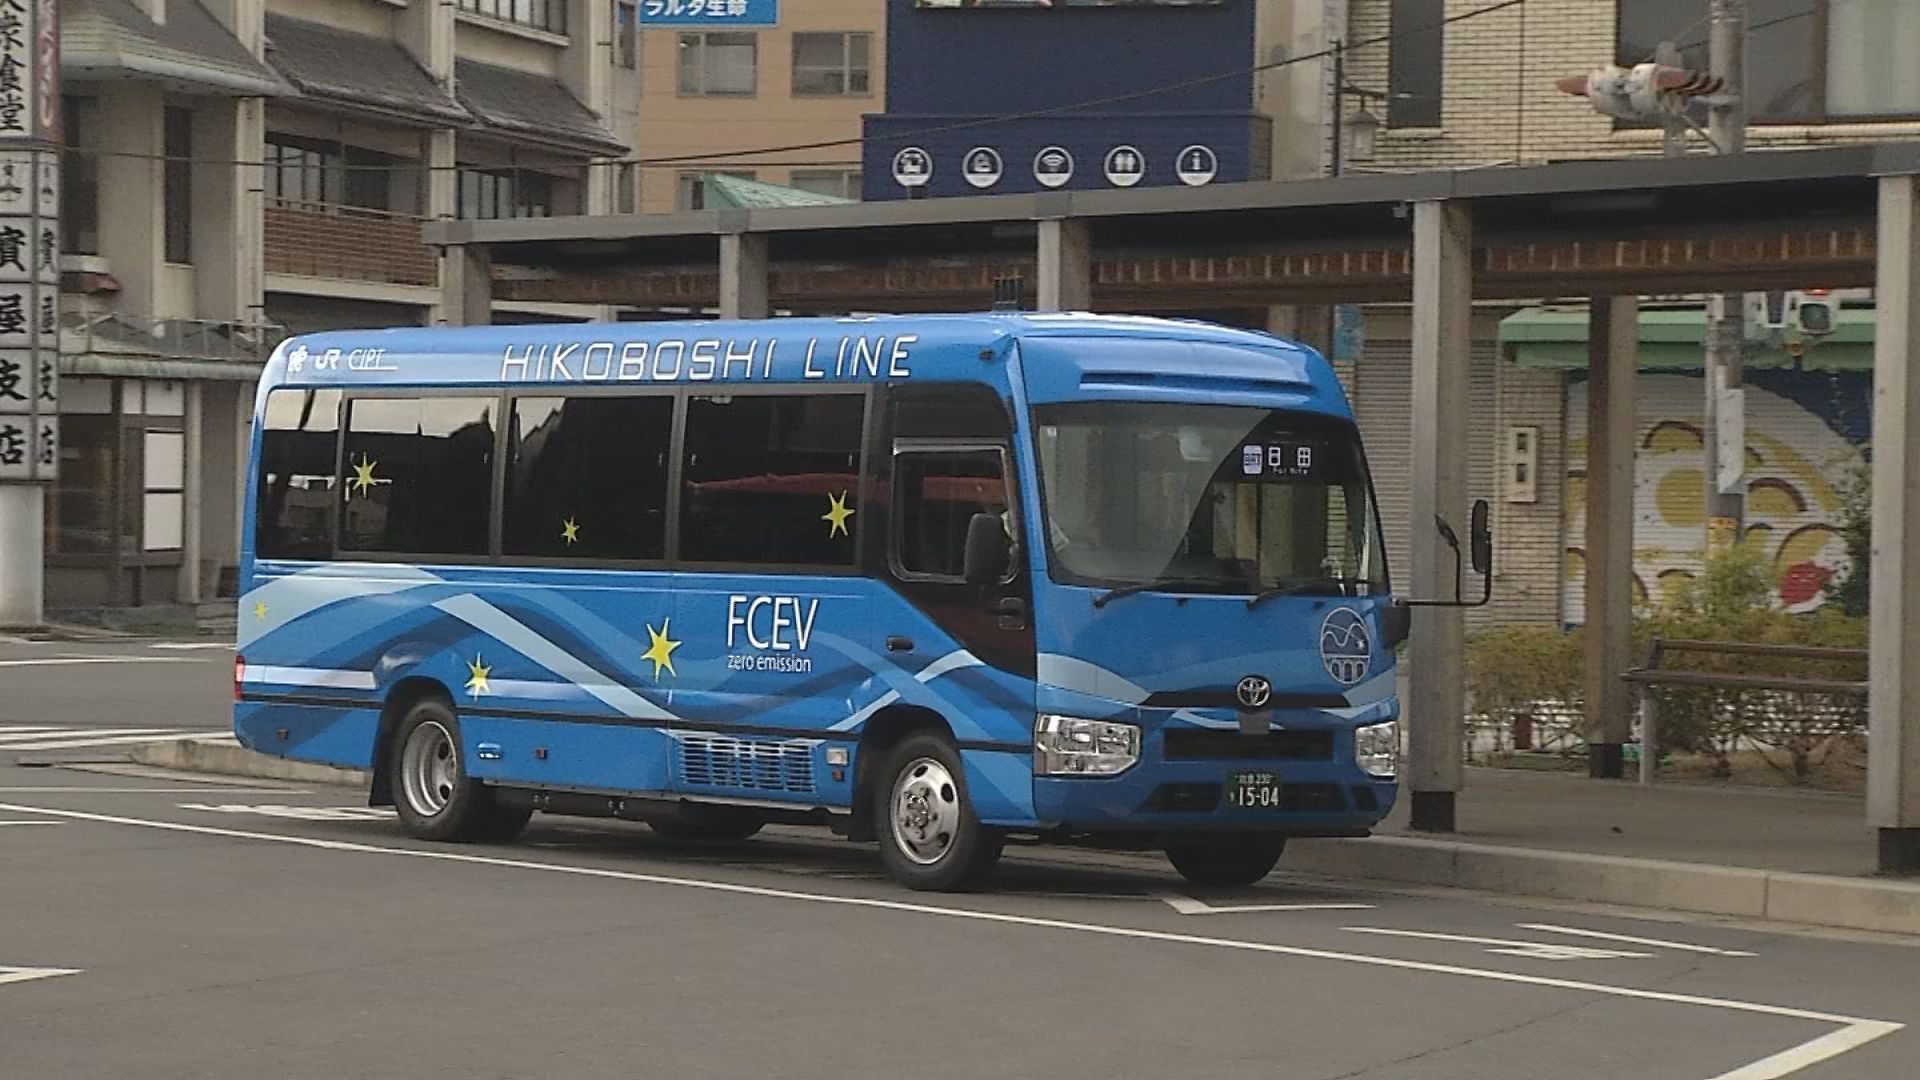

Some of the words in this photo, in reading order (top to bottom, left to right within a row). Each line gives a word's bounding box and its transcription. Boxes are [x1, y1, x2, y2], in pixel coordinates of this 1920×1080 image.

[315, 348, 341, 370] JR
[500, 338, 777, 381] HIKOBOSHI
[804, 335, 918, 378] LINE
[727, 594, 819, 651] FCEV
[727, 654, 755, 671] zero
[756, 653, 812, 673] emission
[1239, 786, 1279, 806] 15-04
